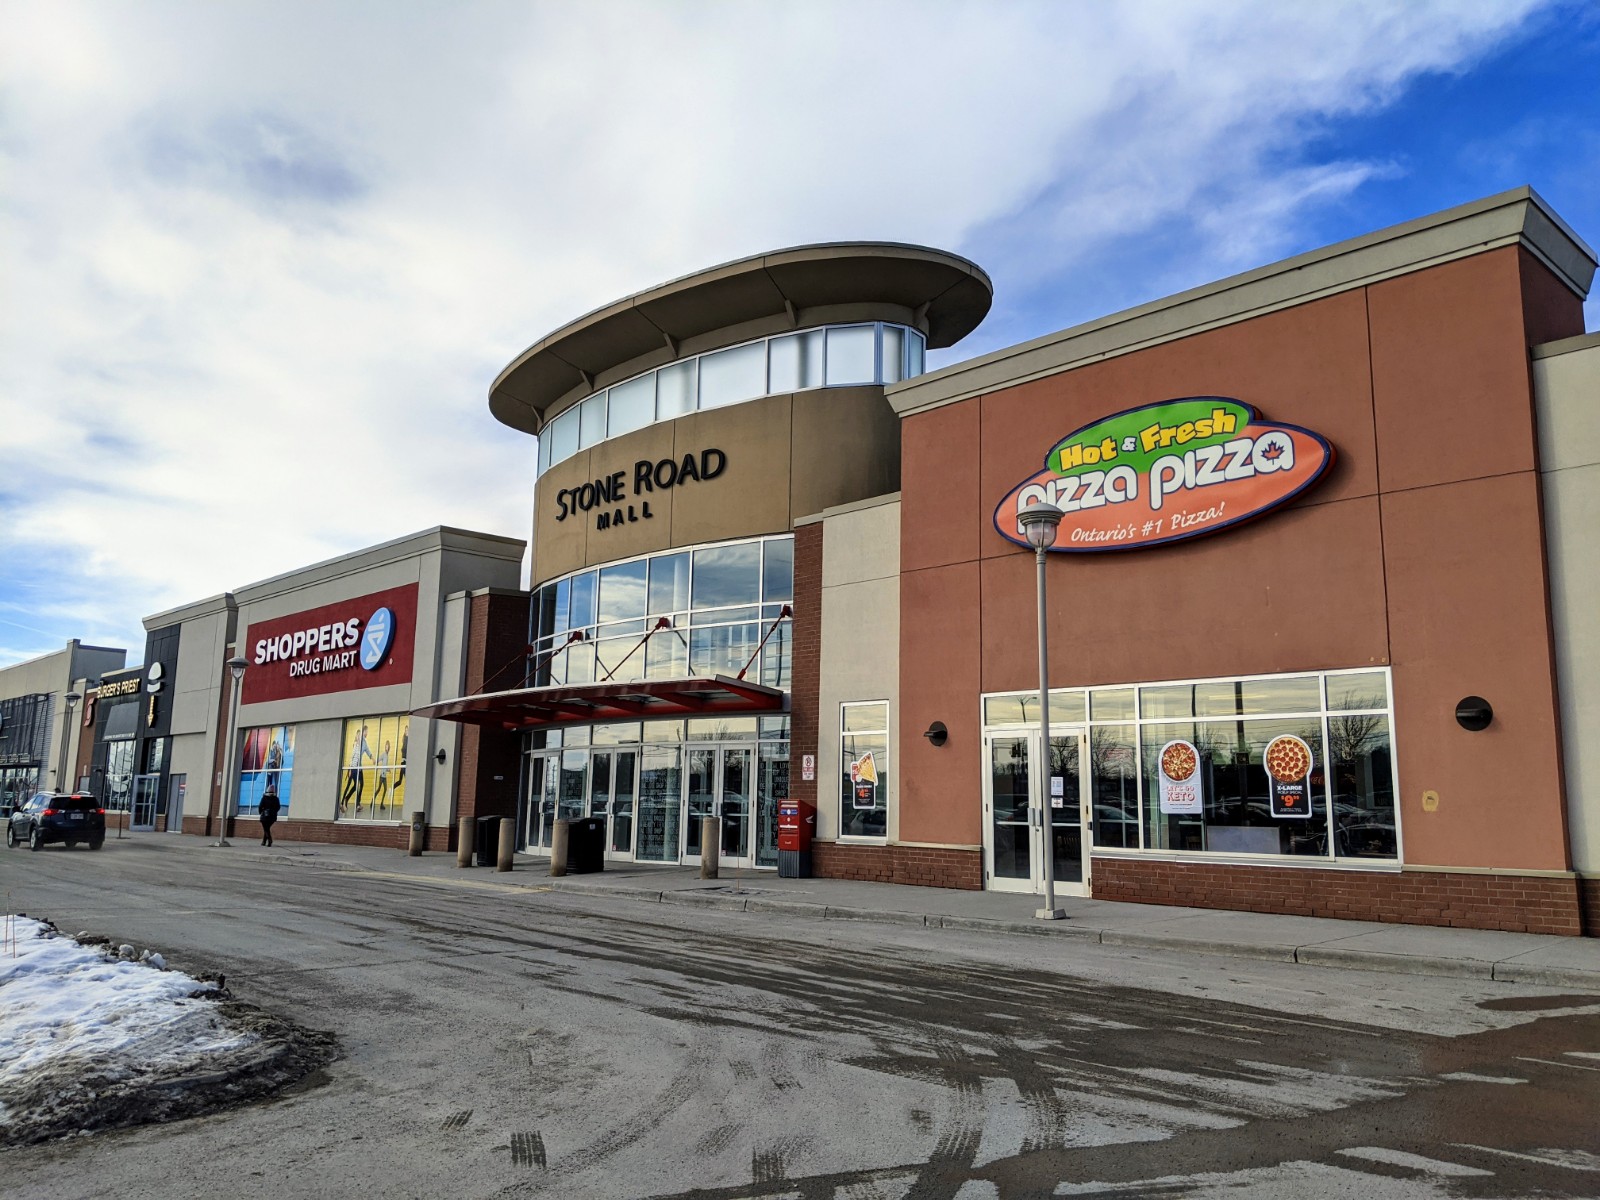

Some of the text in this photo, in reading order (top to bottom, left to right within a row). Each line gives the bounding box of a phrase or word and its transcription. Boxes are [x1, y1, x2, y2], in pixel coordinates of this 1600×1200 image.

[1059, 408, 1237, 471] Hot & Fresh
[556, 448, 727, 521] STONE ROAD
[596, 501, 653, 530] MALL
[1070, 501, 1227, 543] Ontario's #1 Pizza!
[254, 617, 361, 665] SHOPPERS
[289, 650, 358, 677] DRUG MART
[121, 678, 140, 695] PRIEST
[1167, 792, 1196, 802] KETO
